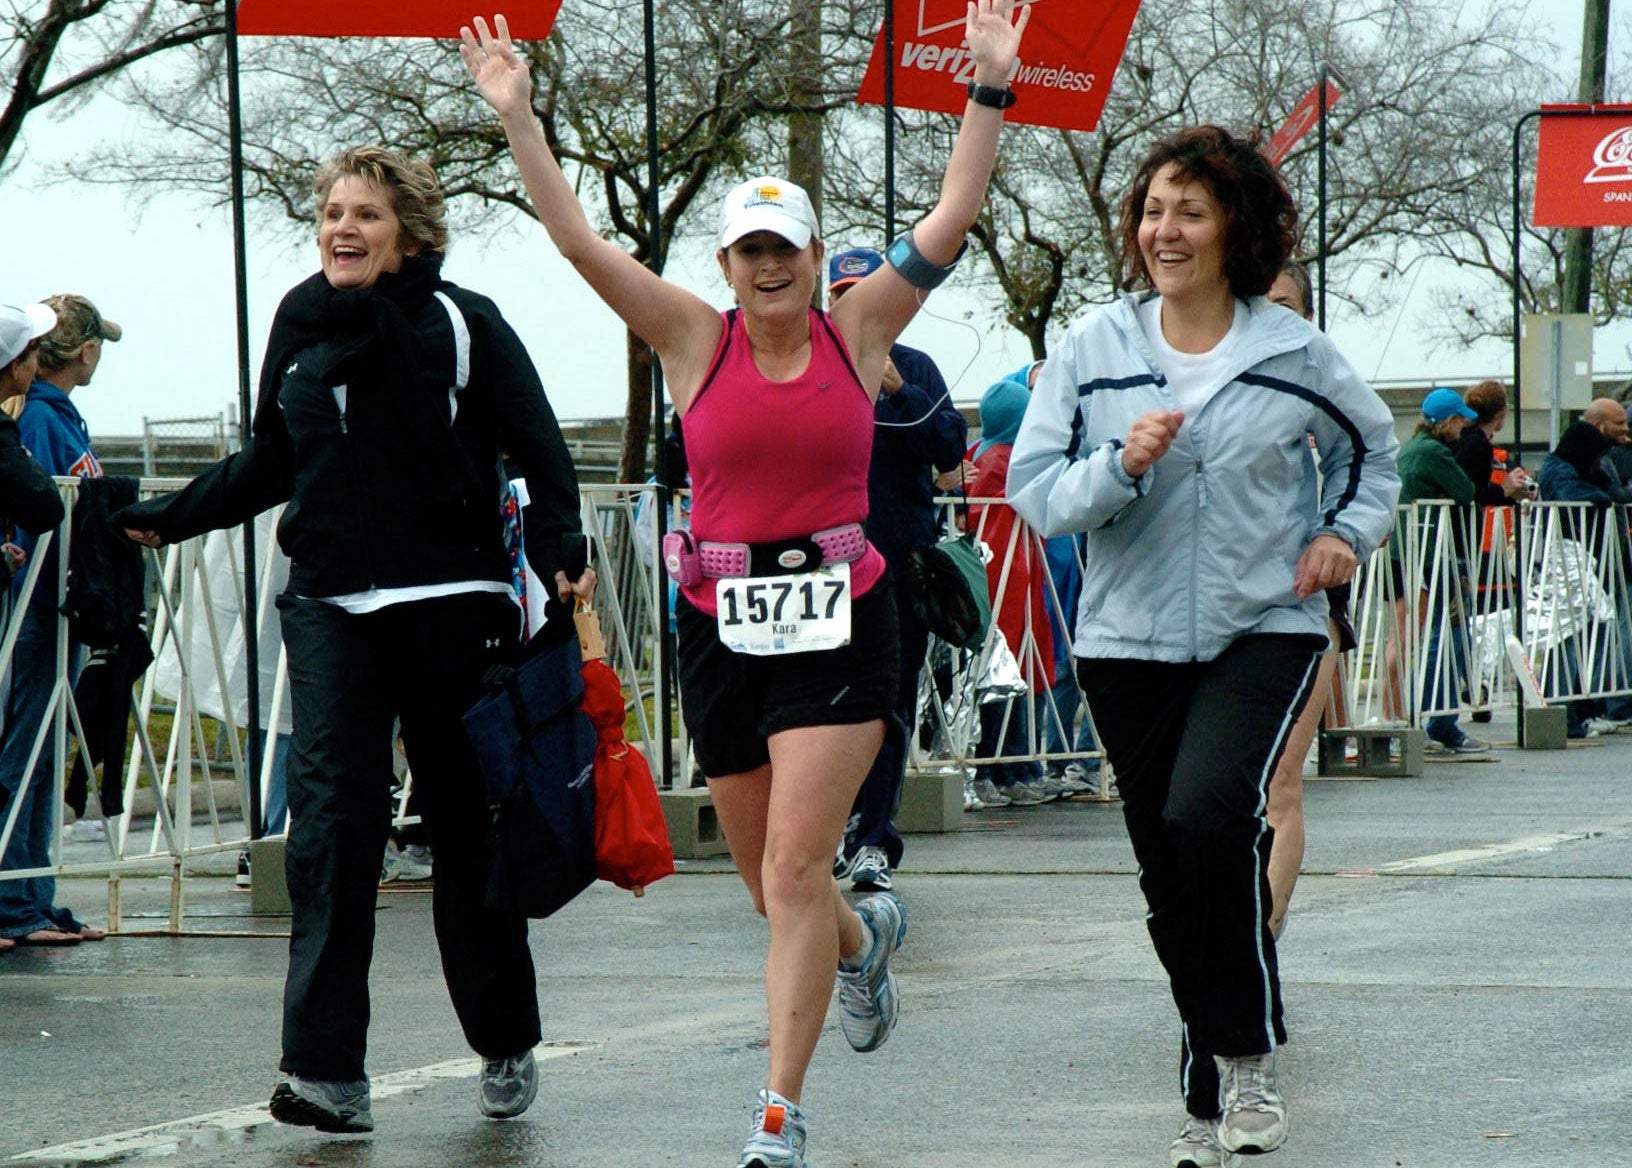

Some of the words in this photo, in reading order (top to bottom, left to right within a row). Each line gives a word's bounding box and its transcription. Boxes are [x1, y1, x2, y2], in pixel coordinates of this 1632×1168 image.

[901, 40, 1022, 85] veriz
[1017, 62, 1096, 93] wireless
[723, 581, 846, 626] 15717
[772, 623, 797, 635] Kara
